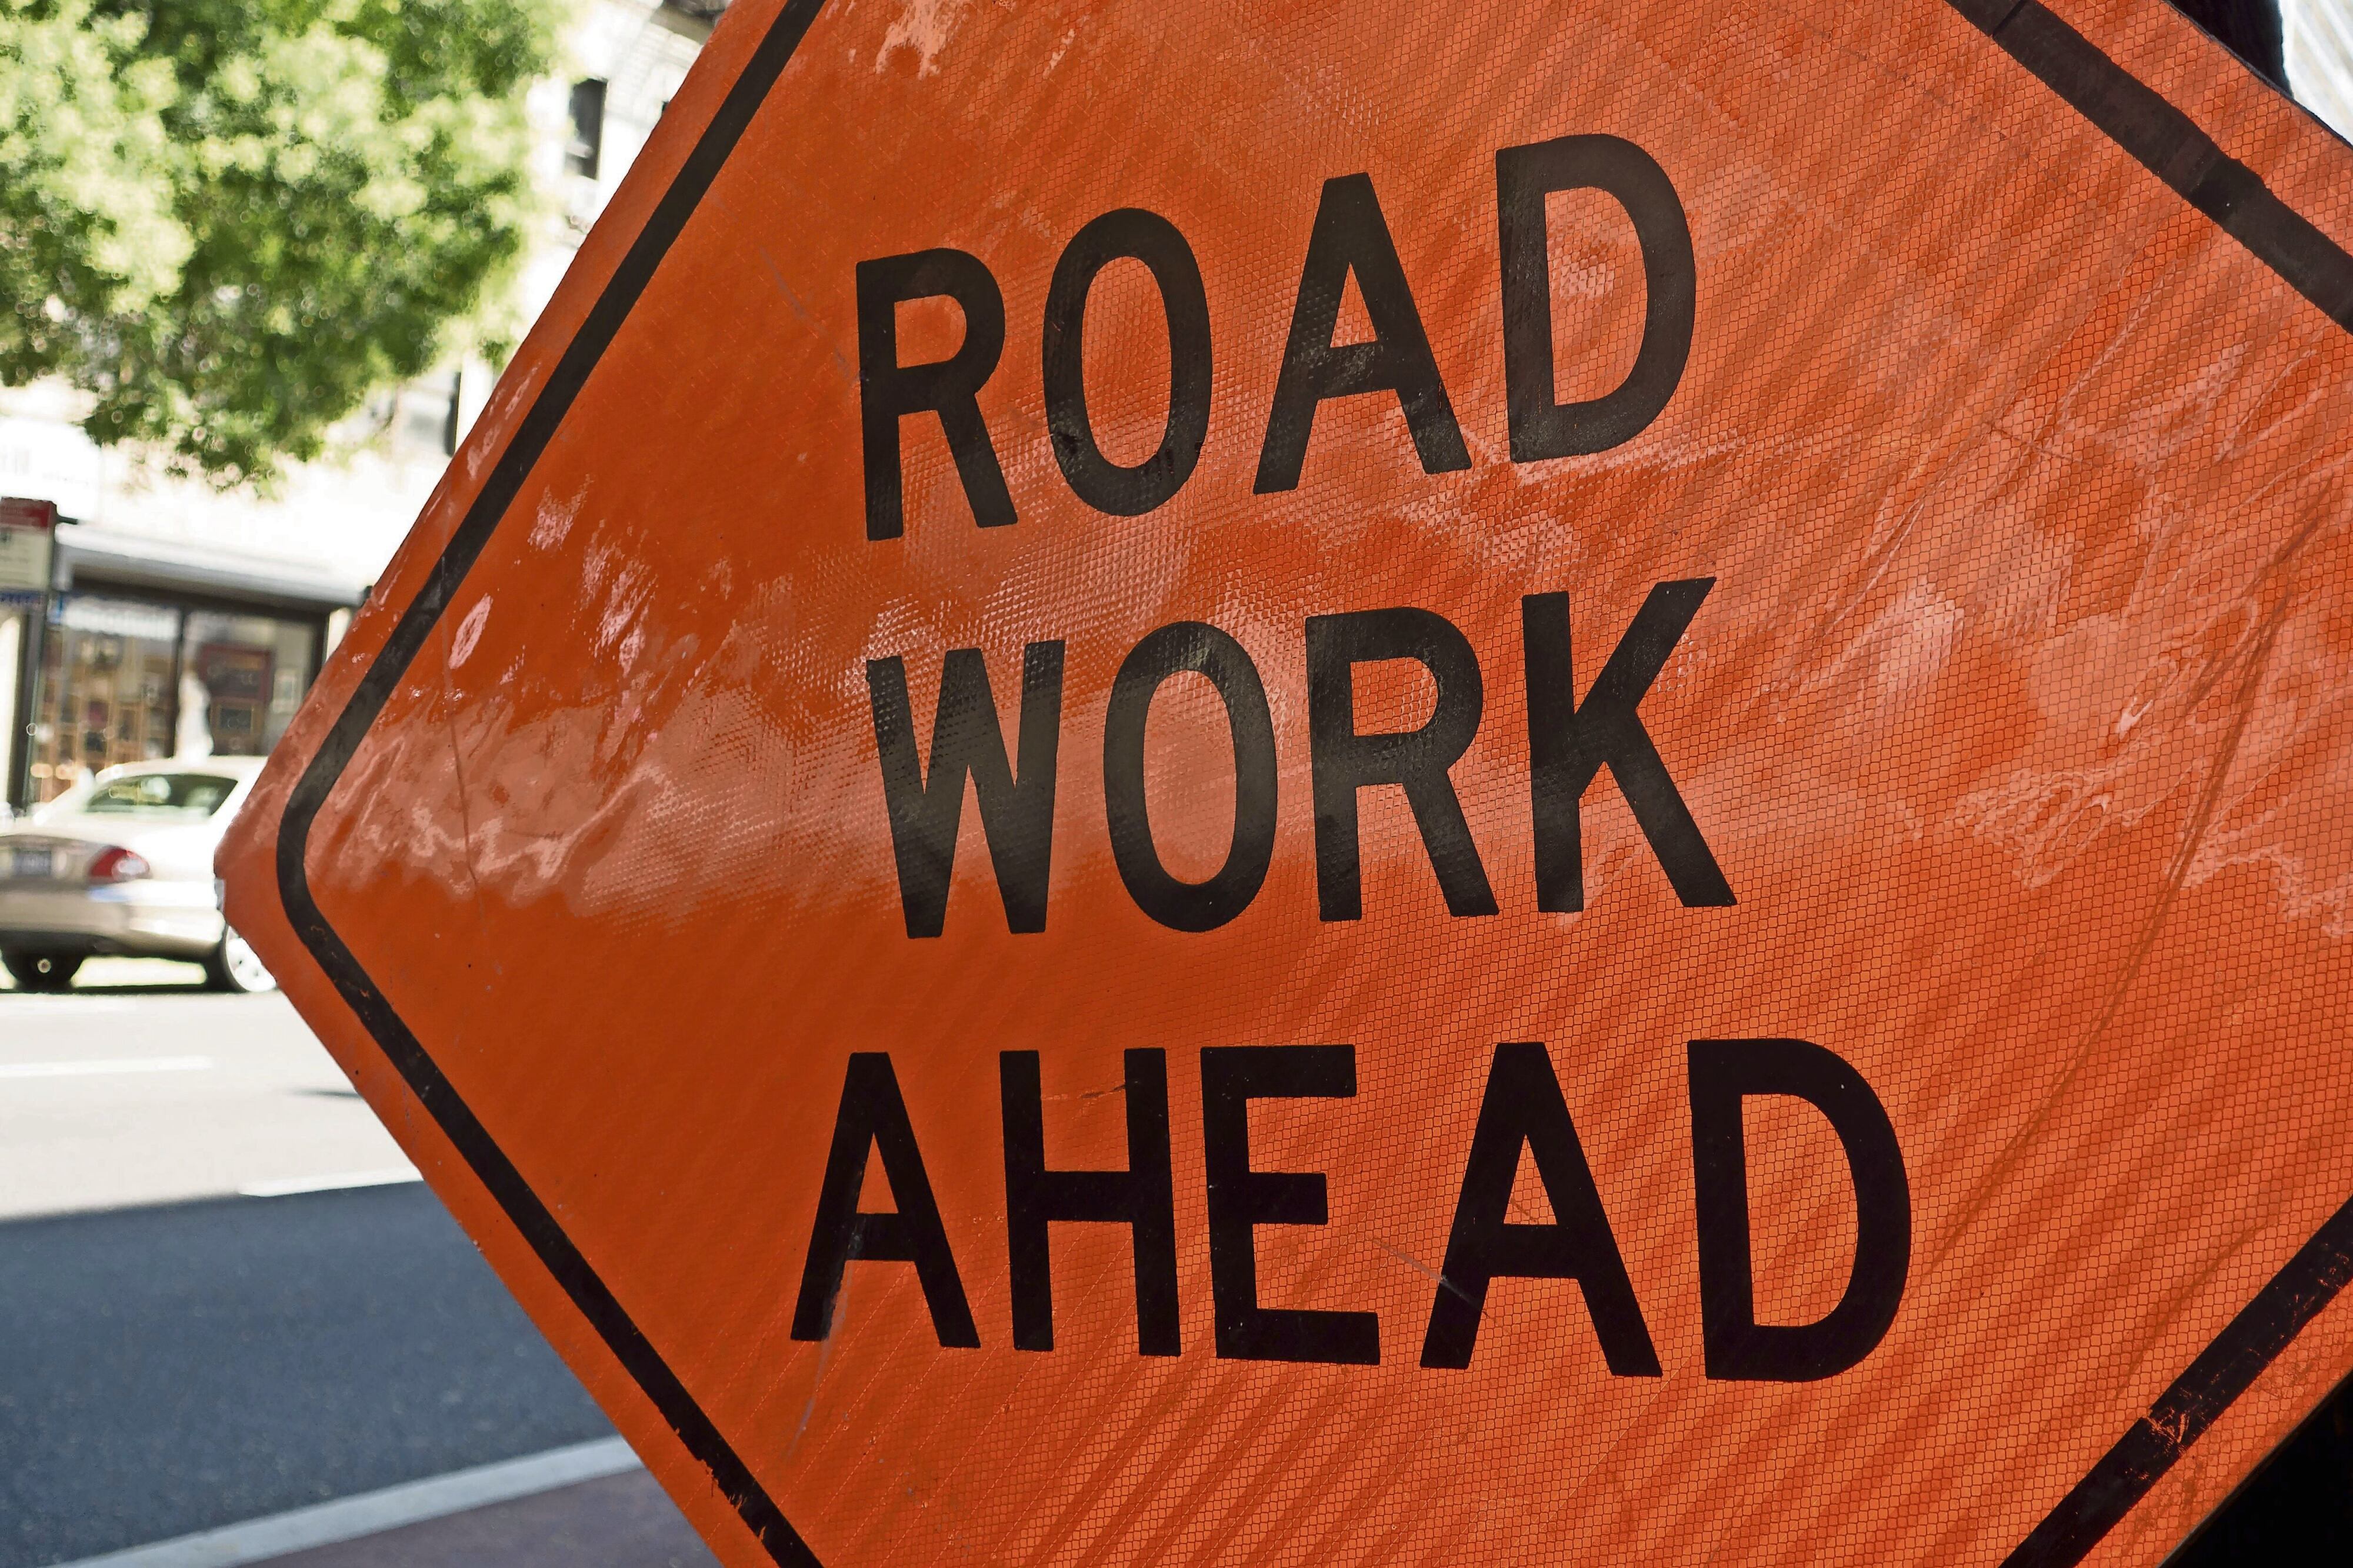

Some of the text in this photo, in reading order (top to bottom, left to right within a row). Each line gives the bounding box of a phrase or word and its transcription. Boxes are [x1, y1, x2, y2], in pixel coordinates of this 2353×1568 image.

[856, 134, 1696, 541] ROAD
[866, 577, 1738, 939] WORK
[790, 1037, 1911, 1383] AHEAD
